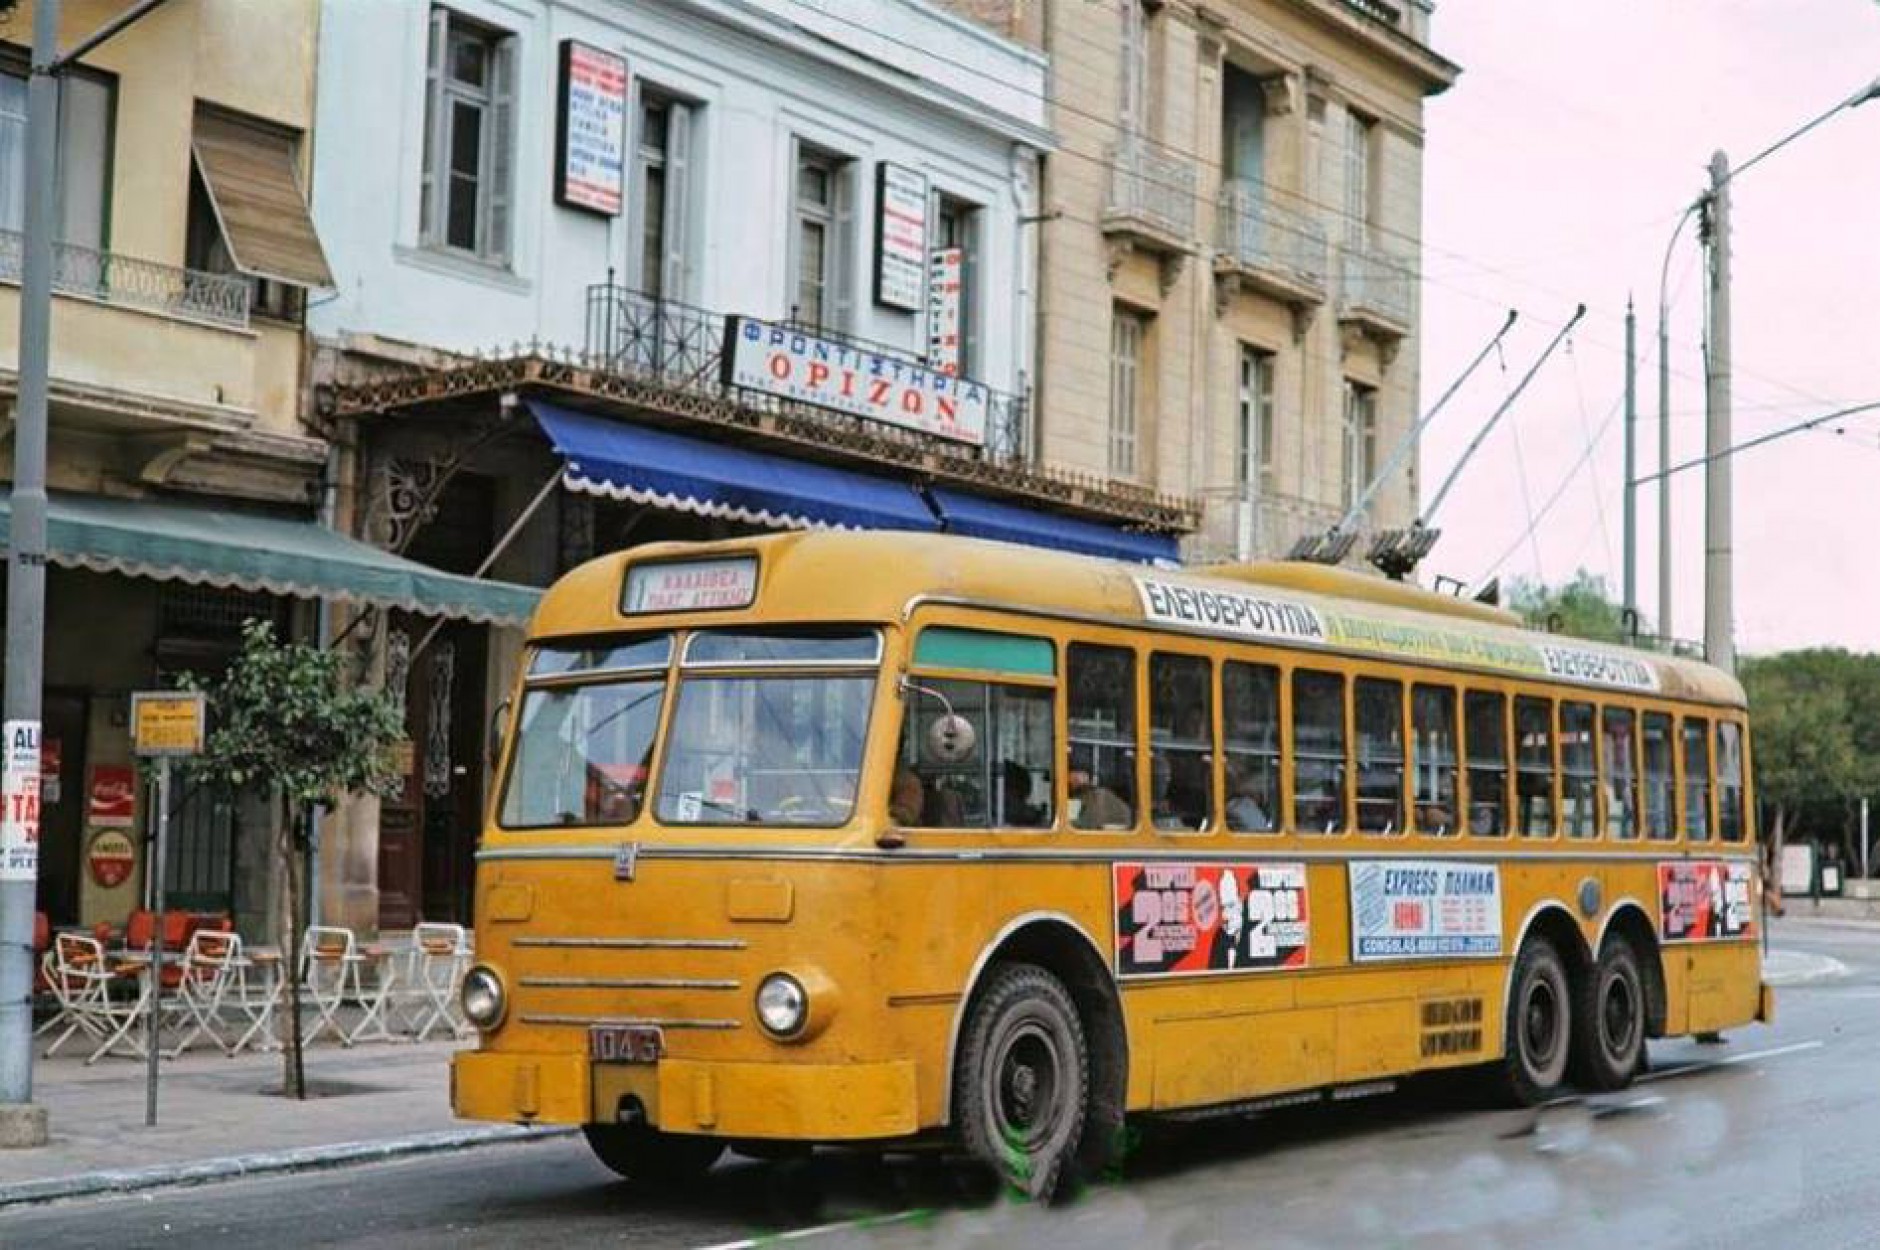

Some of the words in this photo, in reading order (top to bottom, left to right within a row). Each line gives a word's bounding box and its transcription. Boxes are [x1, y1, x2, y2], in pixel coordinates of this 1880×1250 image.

[743, 321, 982, 404] ΦΡΟΝΤΙΣΤΗΡΙΑ
[770, 352, 960, 423] ΟΡΙΖΩΝ
[1145, 582, 1323, 637] ΕΛΕΥΘΕΡΟΤΥΠΙΑ
[1384, 869, 1438, 896] EXPRESS
